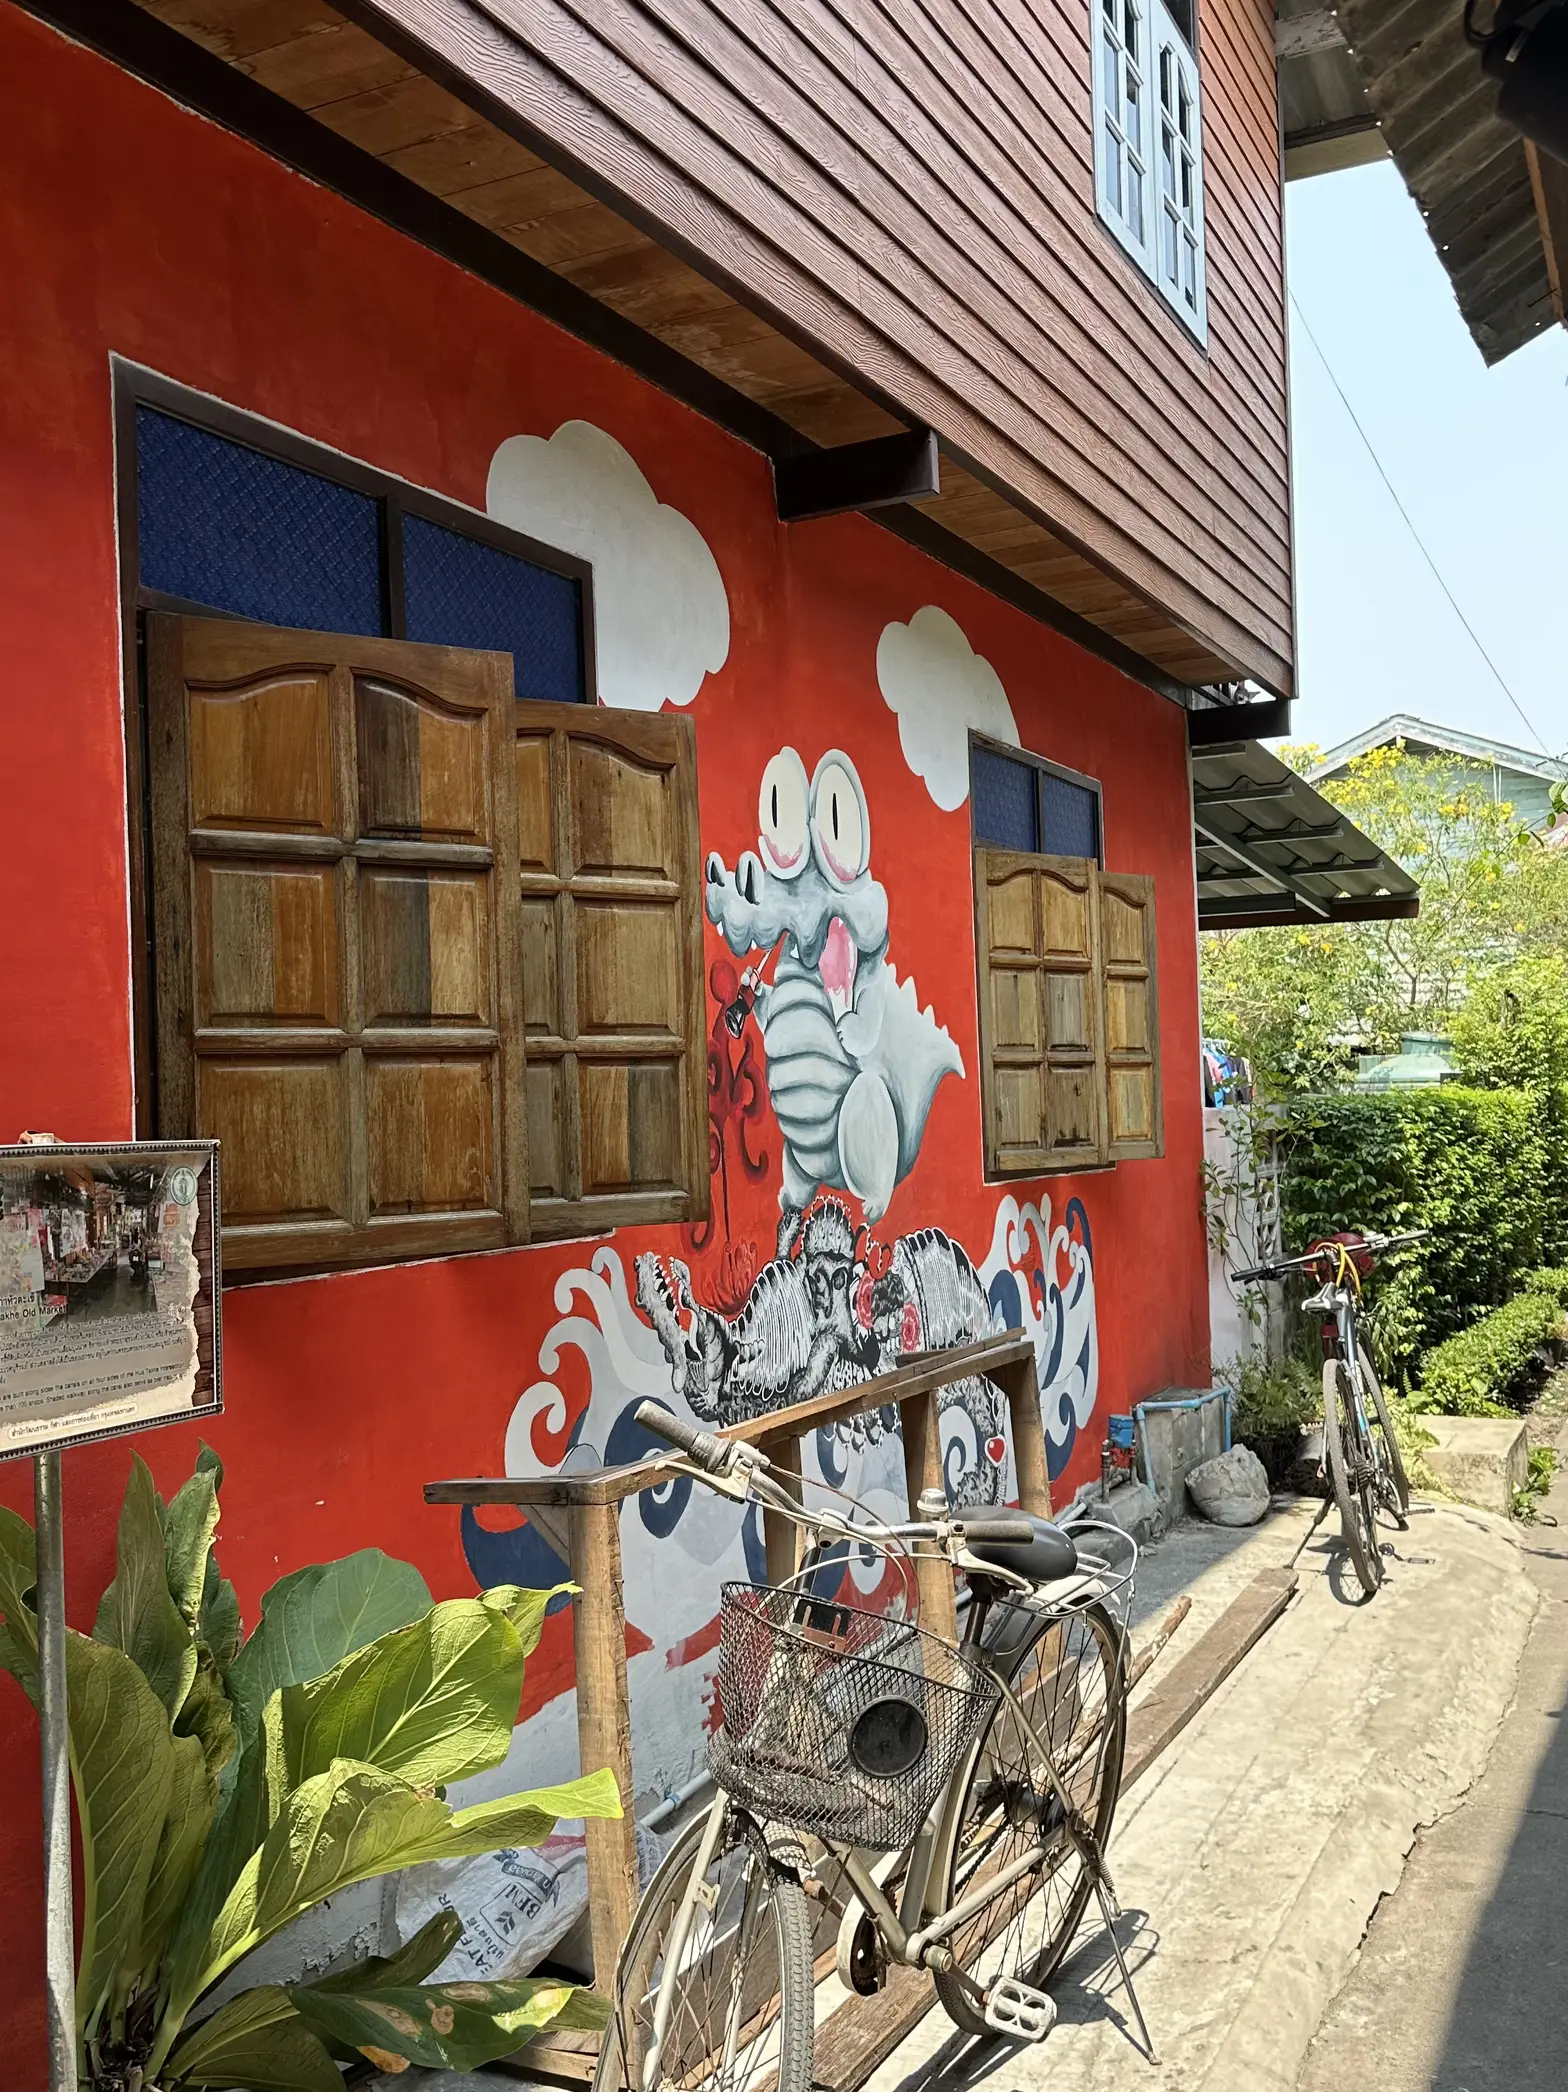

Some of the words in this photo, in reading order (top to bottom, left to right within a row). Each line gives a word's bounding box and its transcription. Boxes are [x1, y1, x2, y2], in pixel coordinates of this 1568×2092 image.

[22, 1308, 35, 1318] Old
[40, 1305, 66, 1315] Market
[505, 1884, 542, 1920] BFM
